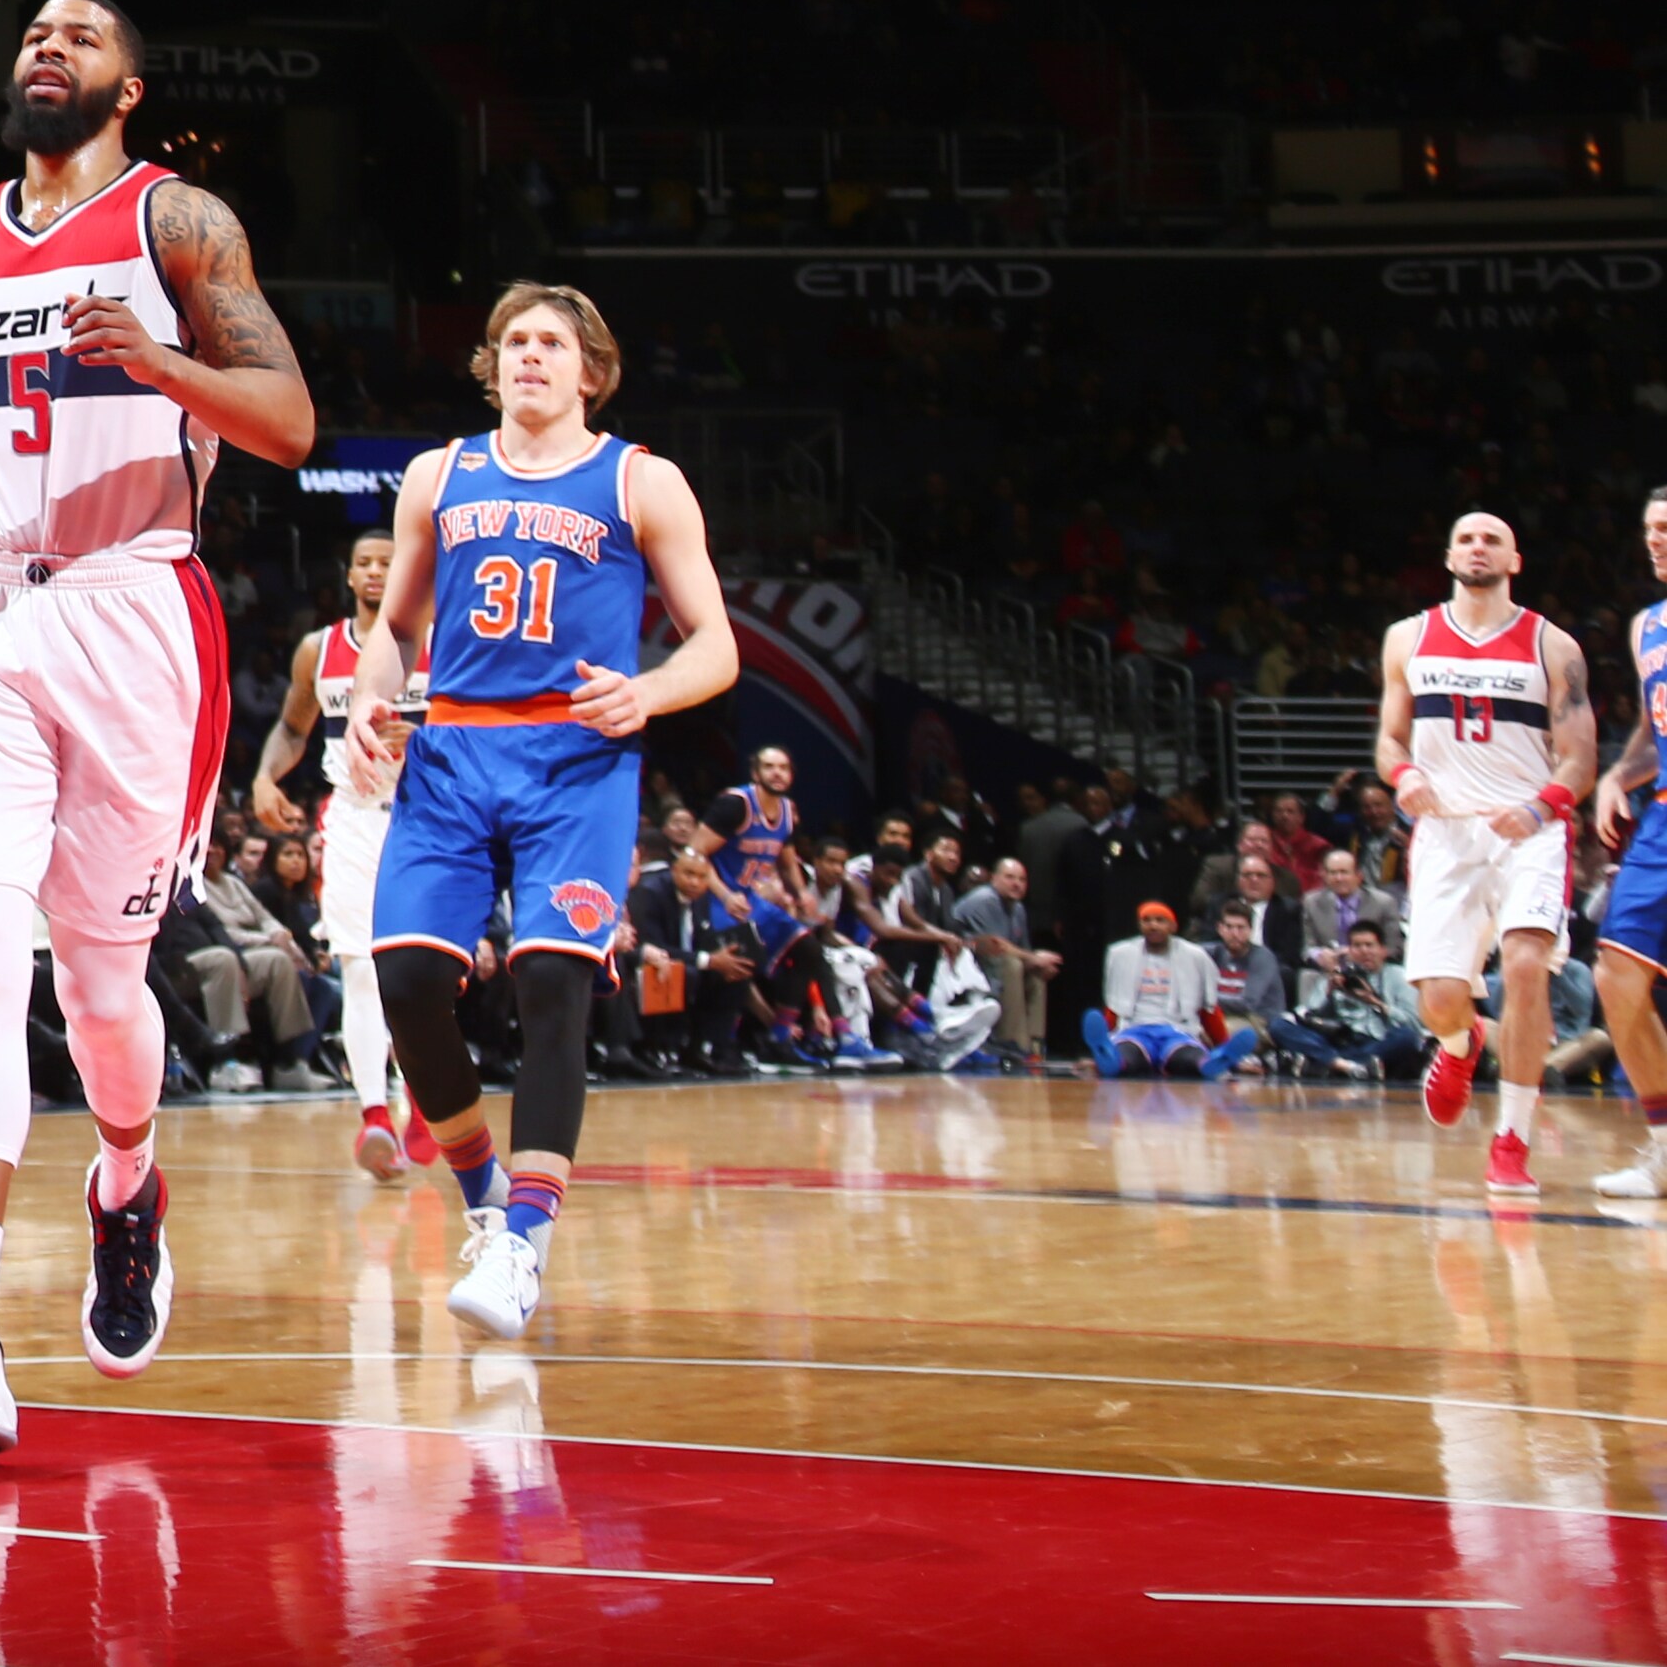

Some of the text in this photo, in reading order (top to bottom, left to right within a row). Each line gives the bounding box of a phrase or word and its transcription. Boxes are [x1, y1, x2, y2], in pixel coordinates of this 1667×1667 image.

[164, 83, 288, 105] AIRWAYS
[794, 261, 1054, 298] ETIHAD
[1381, 254, 1665, 296] ETIHAD
[7, 351, 52, 455] 5
[438, 499, 610, 565] NEW YORK
[470, 555, 559, 646] 31
[1421, 667, 1528, 693] wizards
[1450, 694, 1494, 743] 13
